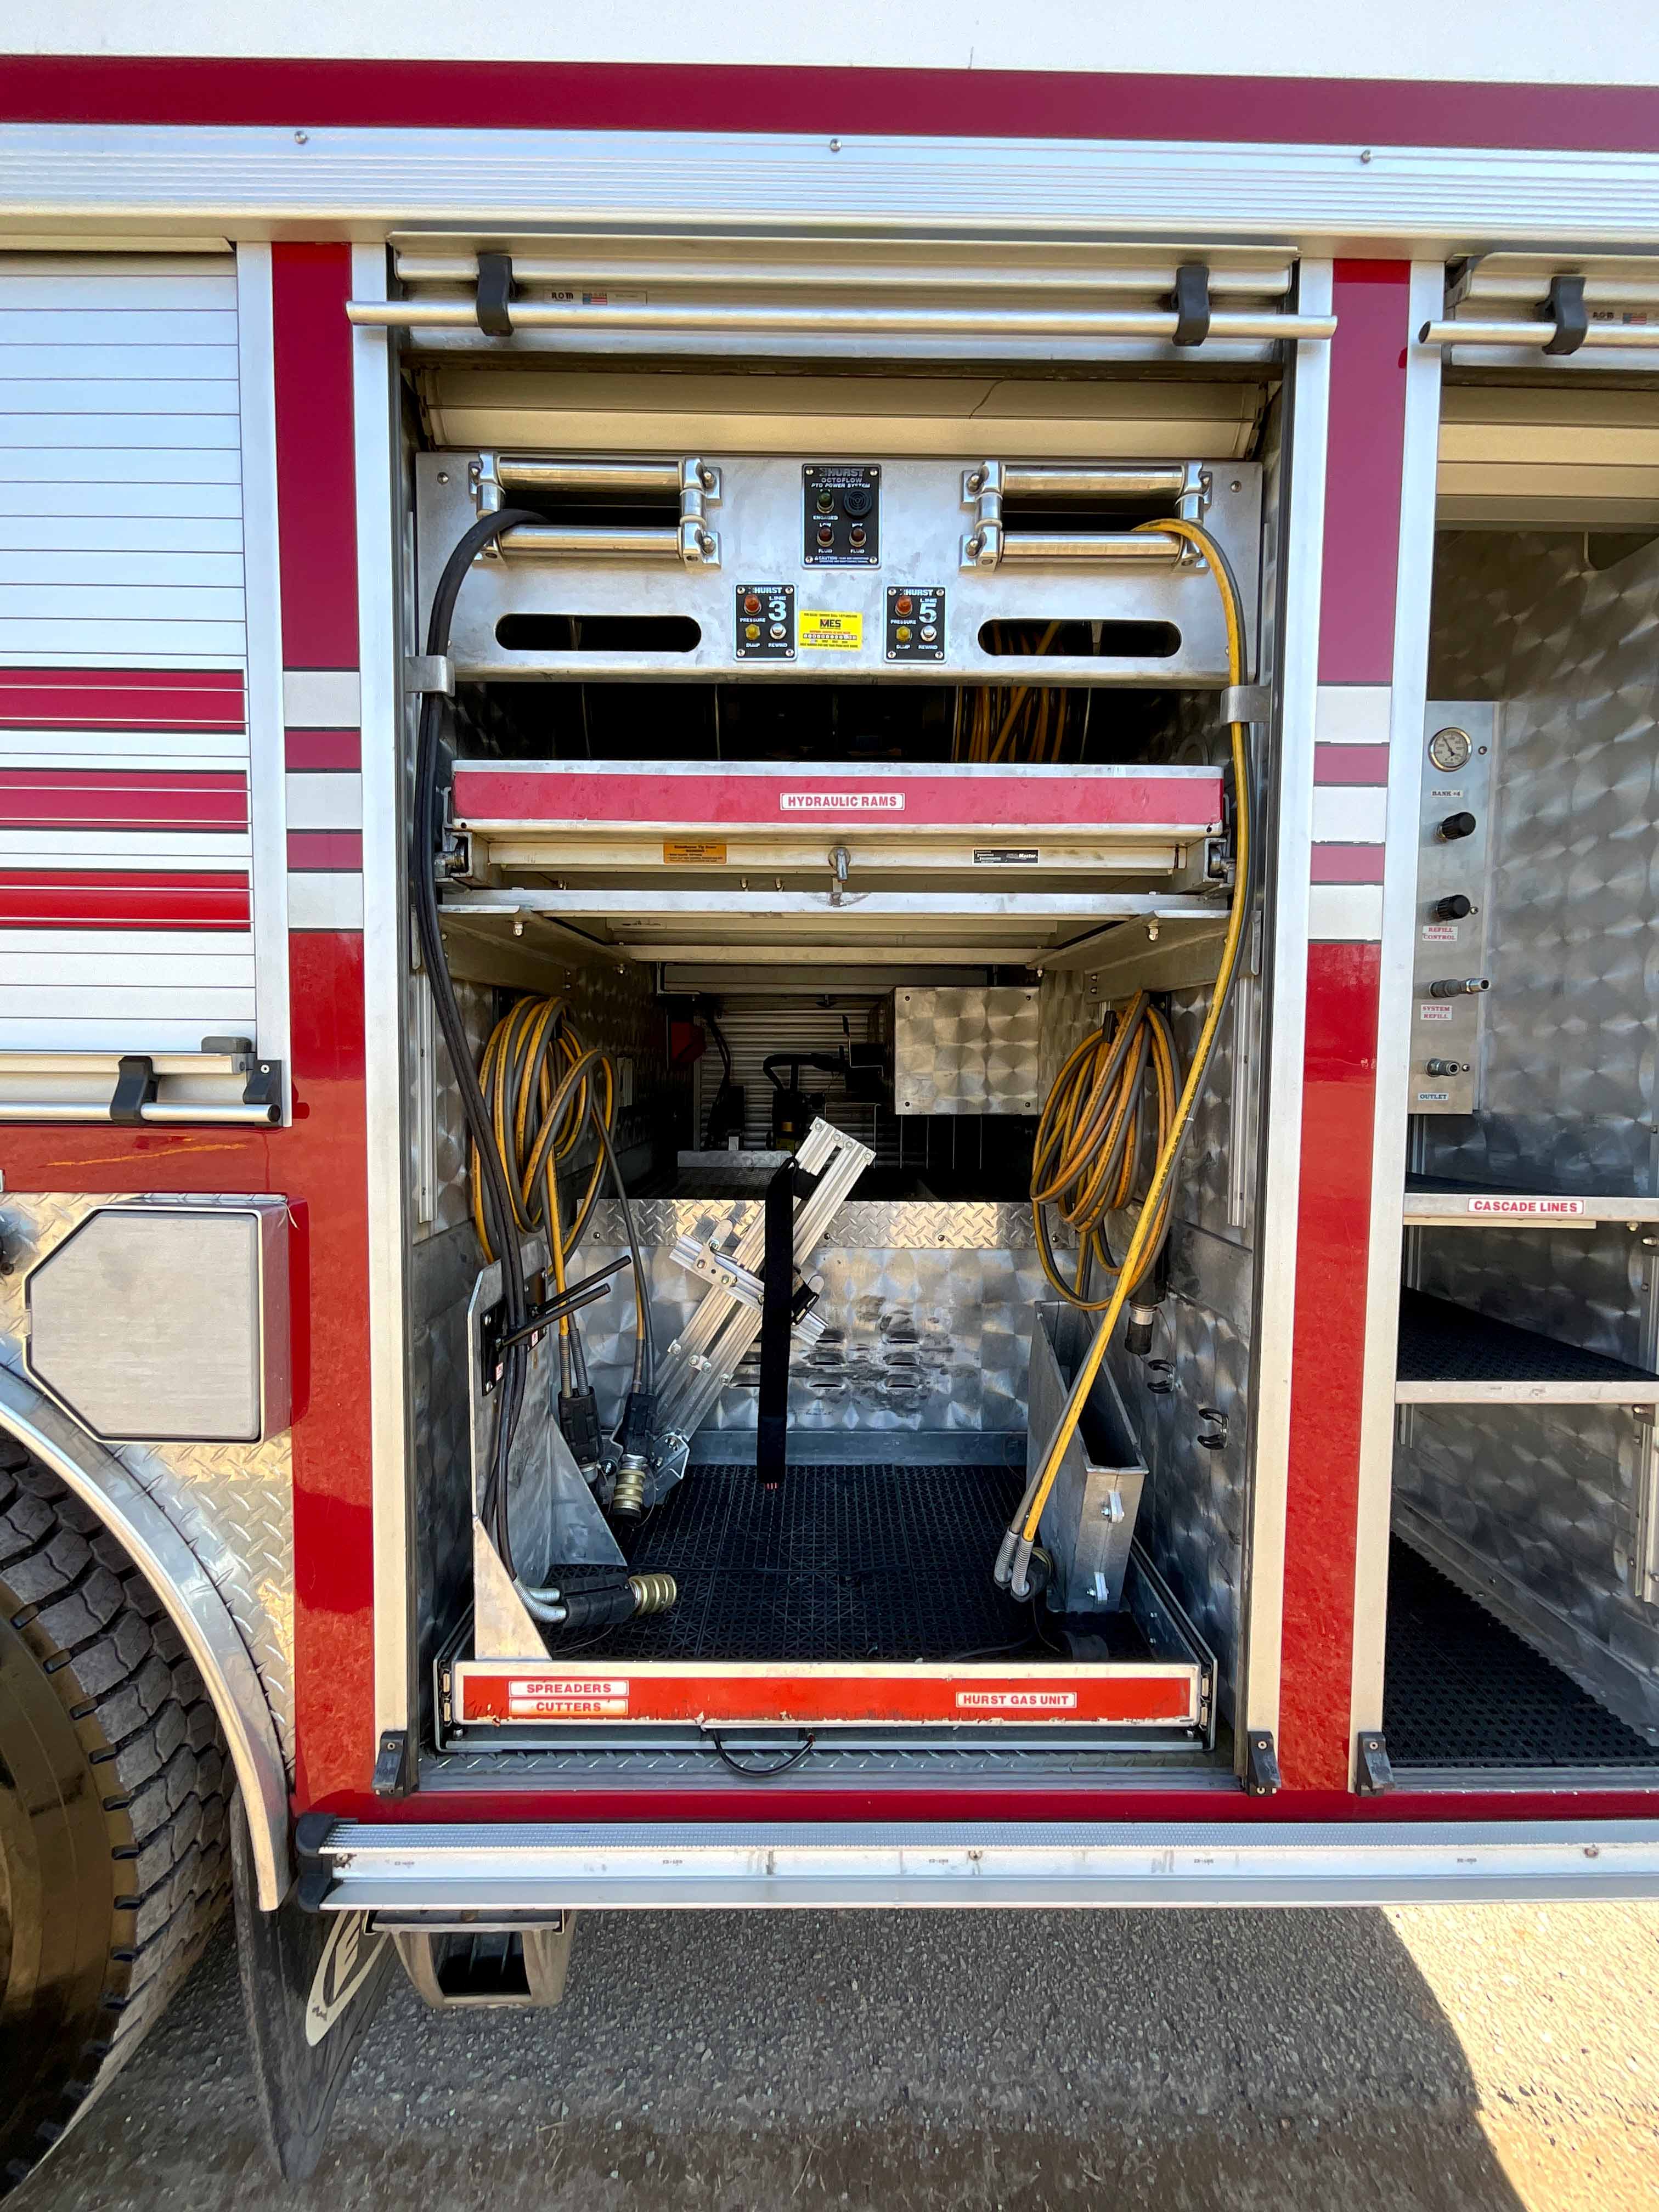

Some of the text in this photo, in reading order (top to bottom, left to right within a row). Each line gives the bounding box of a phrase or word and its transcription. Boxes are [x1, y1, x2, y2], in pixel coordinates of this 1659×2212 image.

[827, 467, 864, 476] HURST
[768, 601, 787, 622] 3
[919, 602, 937, 623] 5
[820, 619, 841, 627] MES
[788, 796, 896, 806] HYDRAULIC RAMS
[1474, 1200, 1577, 1212] CASCADE LINES
[527, 1684, 611, 1693] SPREADERS
[963, 1695, 1069, 1705] HURST GAS UNIT
[536, 1702, 601, 1712] CUTTERS
